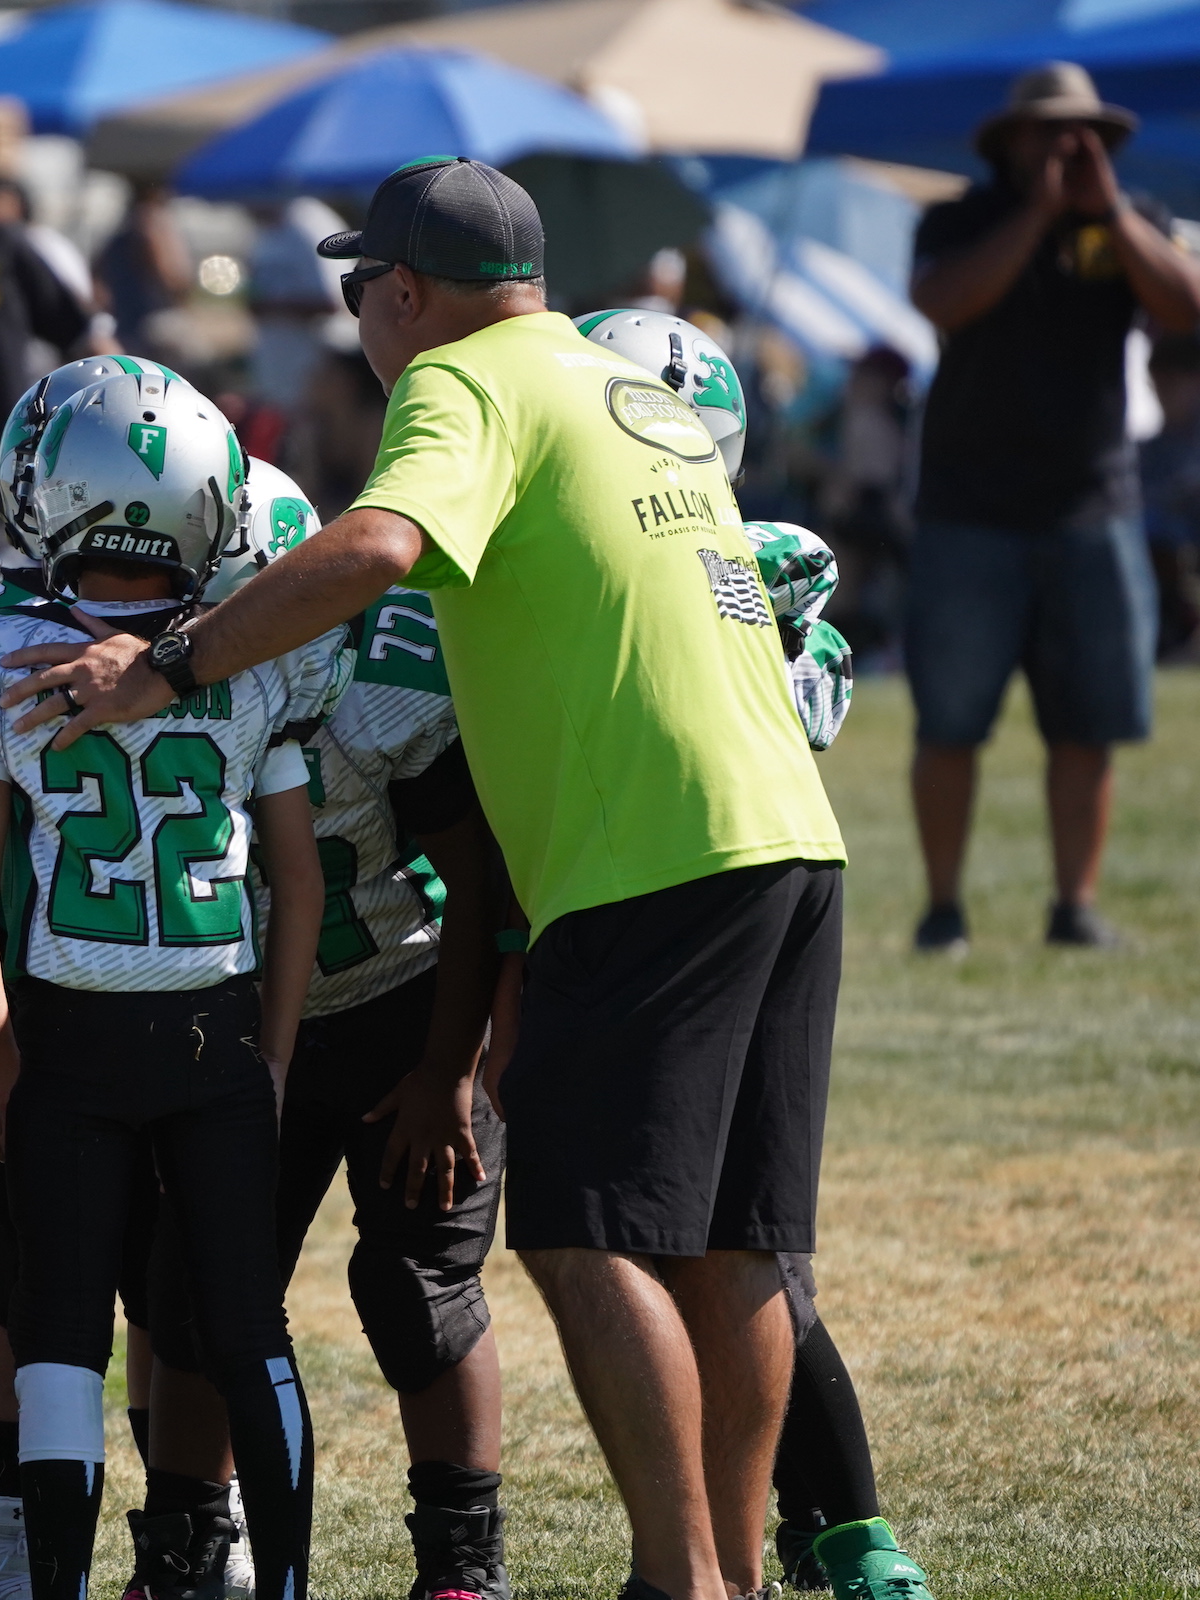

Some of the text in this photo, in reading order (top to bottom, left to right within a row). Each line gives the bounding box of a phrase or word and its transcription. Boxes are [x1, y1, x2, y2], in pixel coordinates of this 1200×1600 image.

[138, 428, 160, 454] F
[650, 458, 681, 474] VISIT
[127, 506, 148, 524] 22
[631, 488, 718, 534] FALLON
[90, 532, 173, 557] schutt
[649, 532, 666, 541] THE
[667, 526, 690, 536] OASIS
[40, 726, 247, 948] 22
